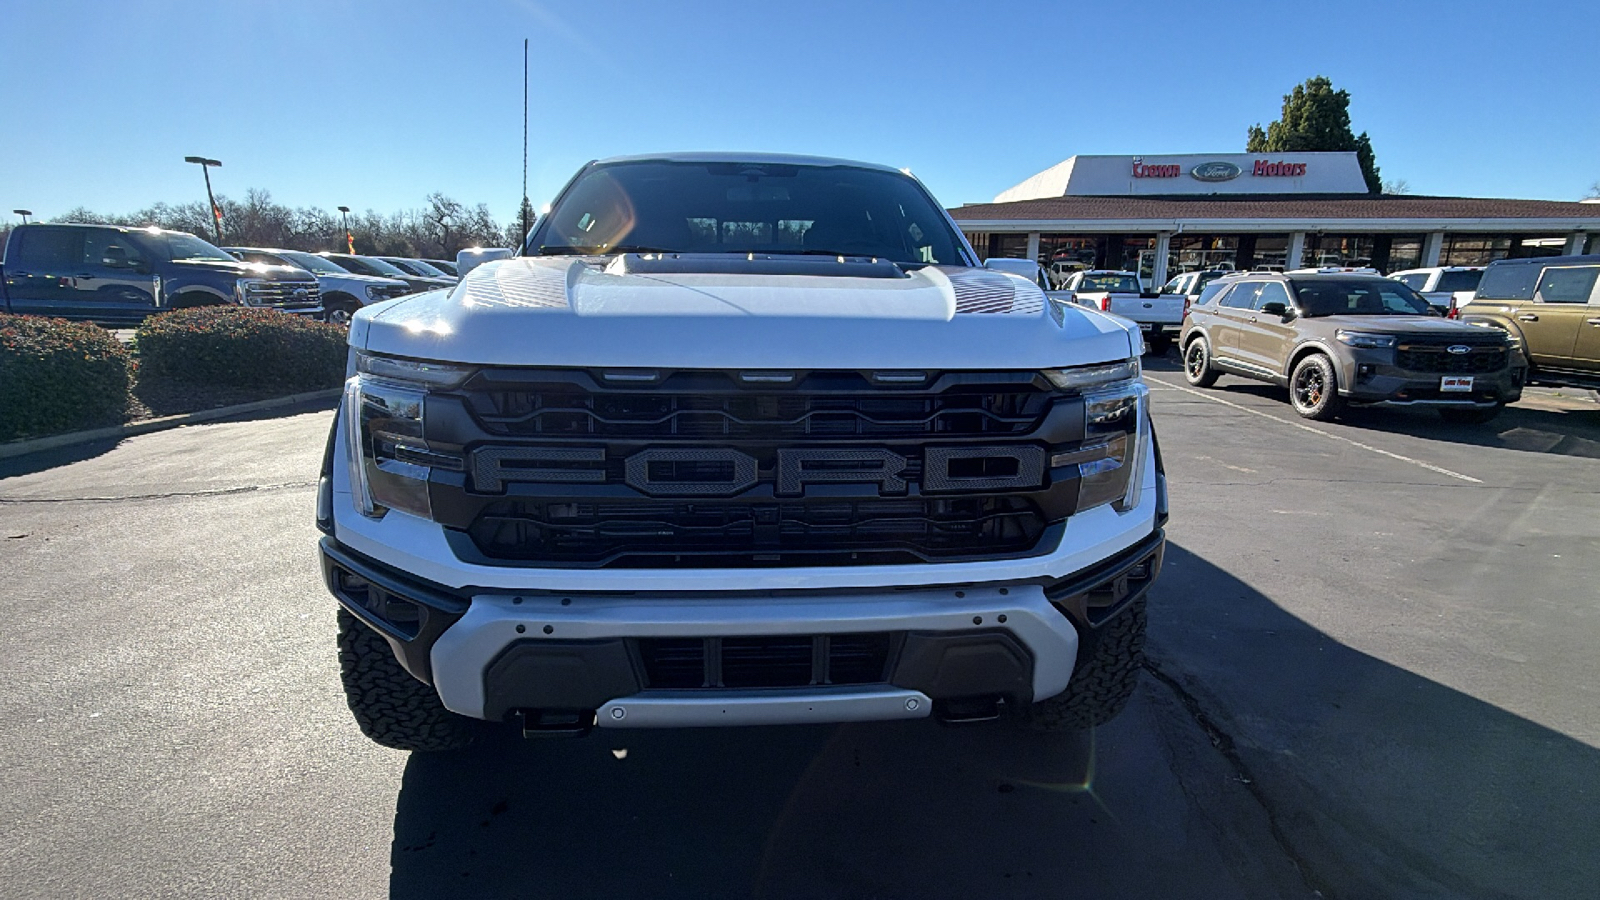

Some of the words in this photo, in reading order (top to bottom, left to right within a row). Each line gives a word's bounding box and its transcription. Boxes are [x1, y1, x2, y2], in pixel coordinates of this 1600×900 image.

[1132, 161, 1180, 178] Crown
[1204, 166, 1231, 177] Ford
[1253, 159, 1307, 176] Motors
[473, 446, 1044, 496] FORD
